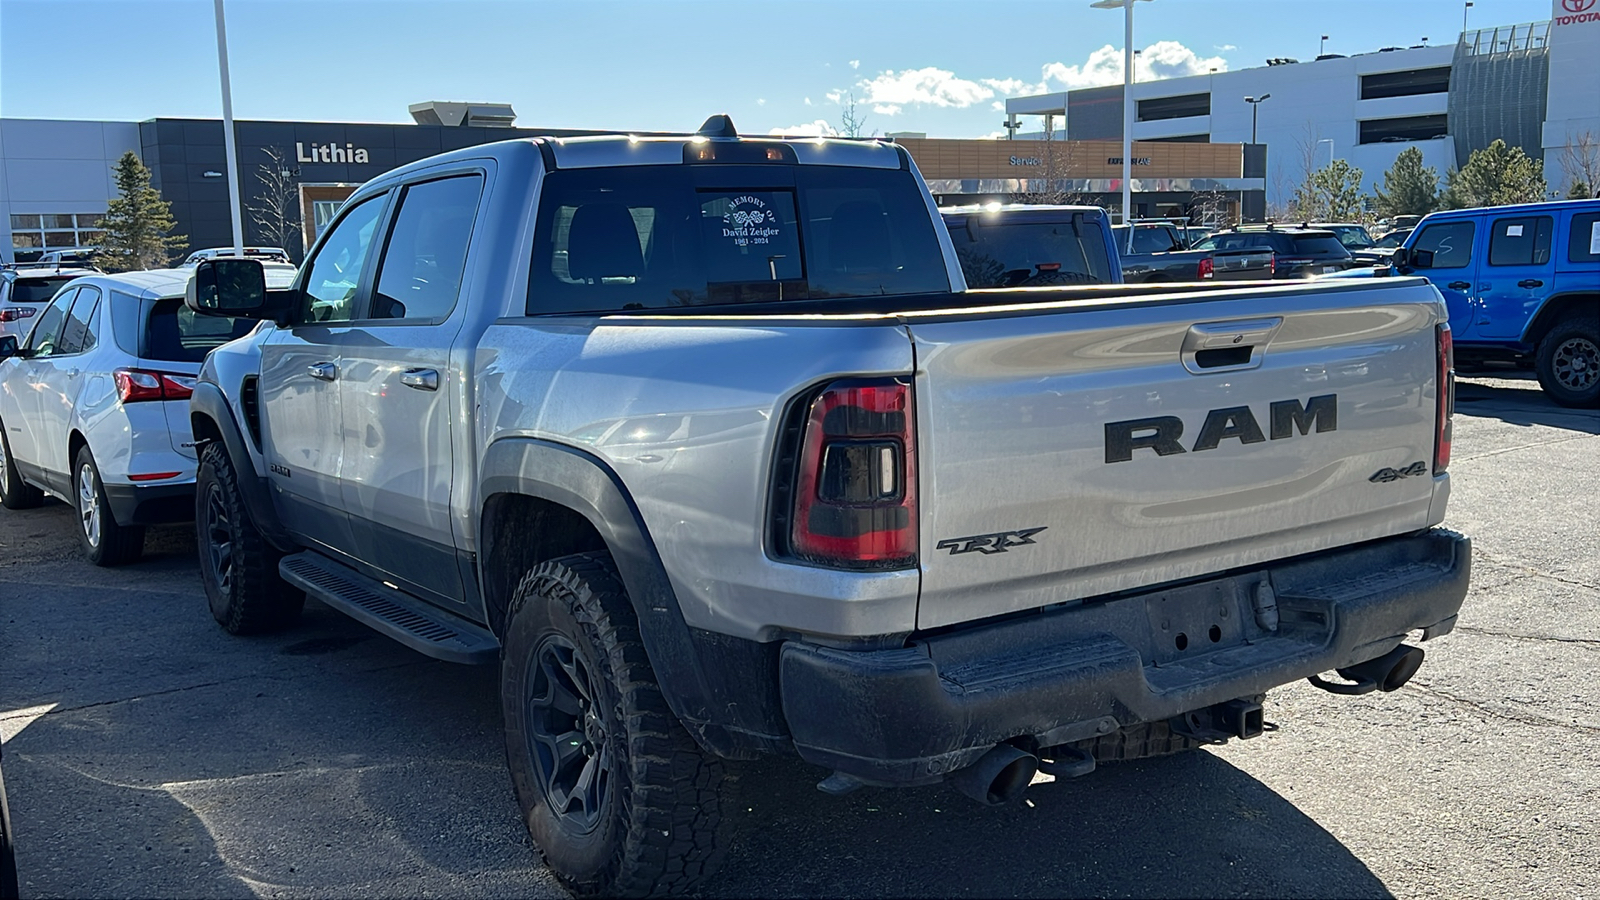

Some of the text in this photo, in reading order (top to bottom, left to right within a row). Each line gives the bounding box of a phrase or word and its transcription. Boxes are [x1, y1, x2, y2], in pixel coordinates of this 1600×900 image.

[1555, 12, 1600, 26] TOYOTA
[296, 142, 369, 163] Lithia
[723, 196, 776, 224] IN MEMORY OF
[723, 228, 779, 237] David Zeigler
[754, 237, 769, 245] 2024
[1105, 393, 1338, 464] RAM
[936, 526, 1048, 555] TRX
